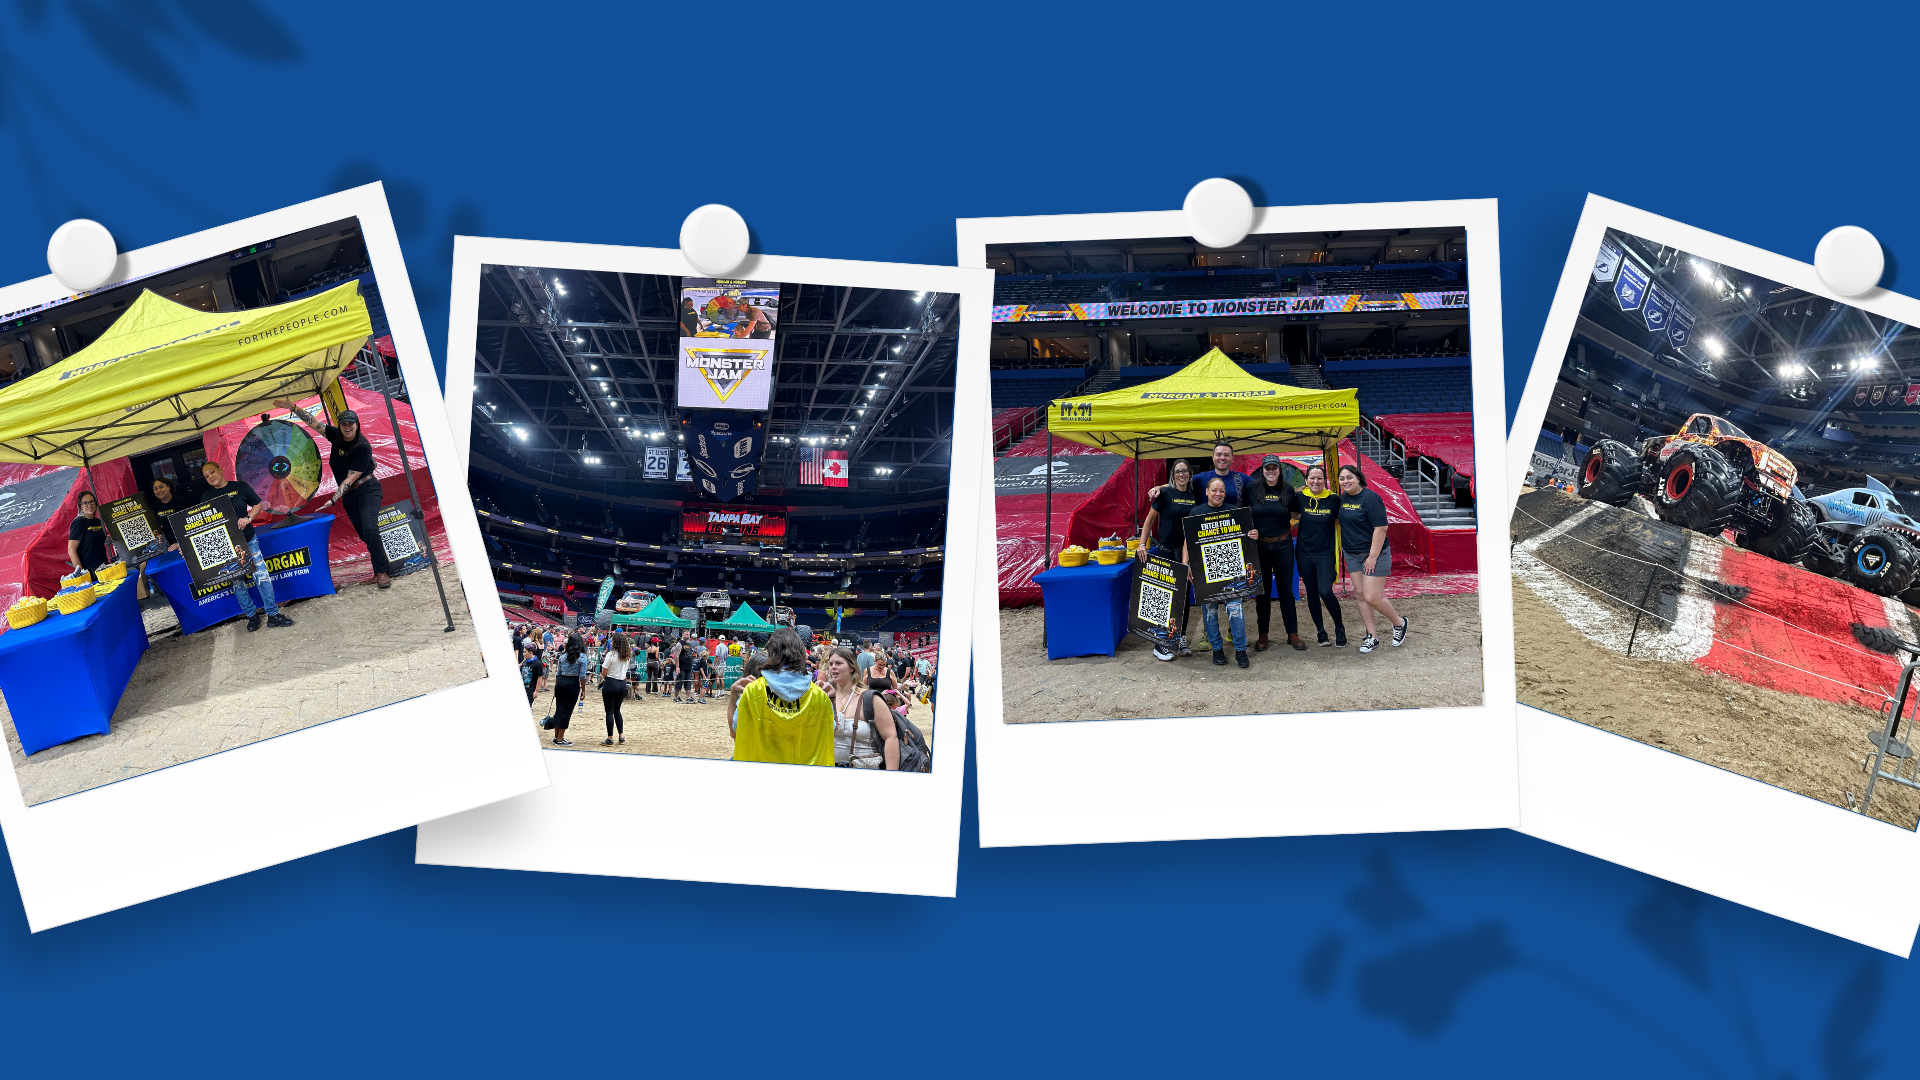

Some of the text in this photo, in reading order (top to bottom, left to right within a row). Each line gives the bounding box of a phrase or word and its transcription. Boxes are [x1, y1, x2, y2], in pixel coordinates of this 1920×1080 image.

[1108, 299, 1325, 316] WELCOME TO MONSTER JAM
[238, 305, 348, 346] FORTHEPEOPLE.COM
[686, 357, 765, 370] MONSTER
[707, 369, 742, 380] JAM
[1270, 403, 1347, 411] FORTHEPEOPLE.COM
[647, 457, 666, 470] 26
[186, 512, 202, 523] ENTER
[202, 510, 213, 520] FOR
[708, 512, 763, 524] TAMPA BAY
[184, 520, 205, 531] CHANCE
[204, 516, 212, 524] TO
[1201, 521, 1219, 530] ENTER
[1219, 520, 1230, 528] FOR
[1198, 527, 1220, 537] CHANCE
[266, 550, 305, 573] ORGAN
[294, 568, 310, 576] FIRM
[1159, 573, 1165, 581] TO
[198, 591, 230, 606] AMERICA'S
